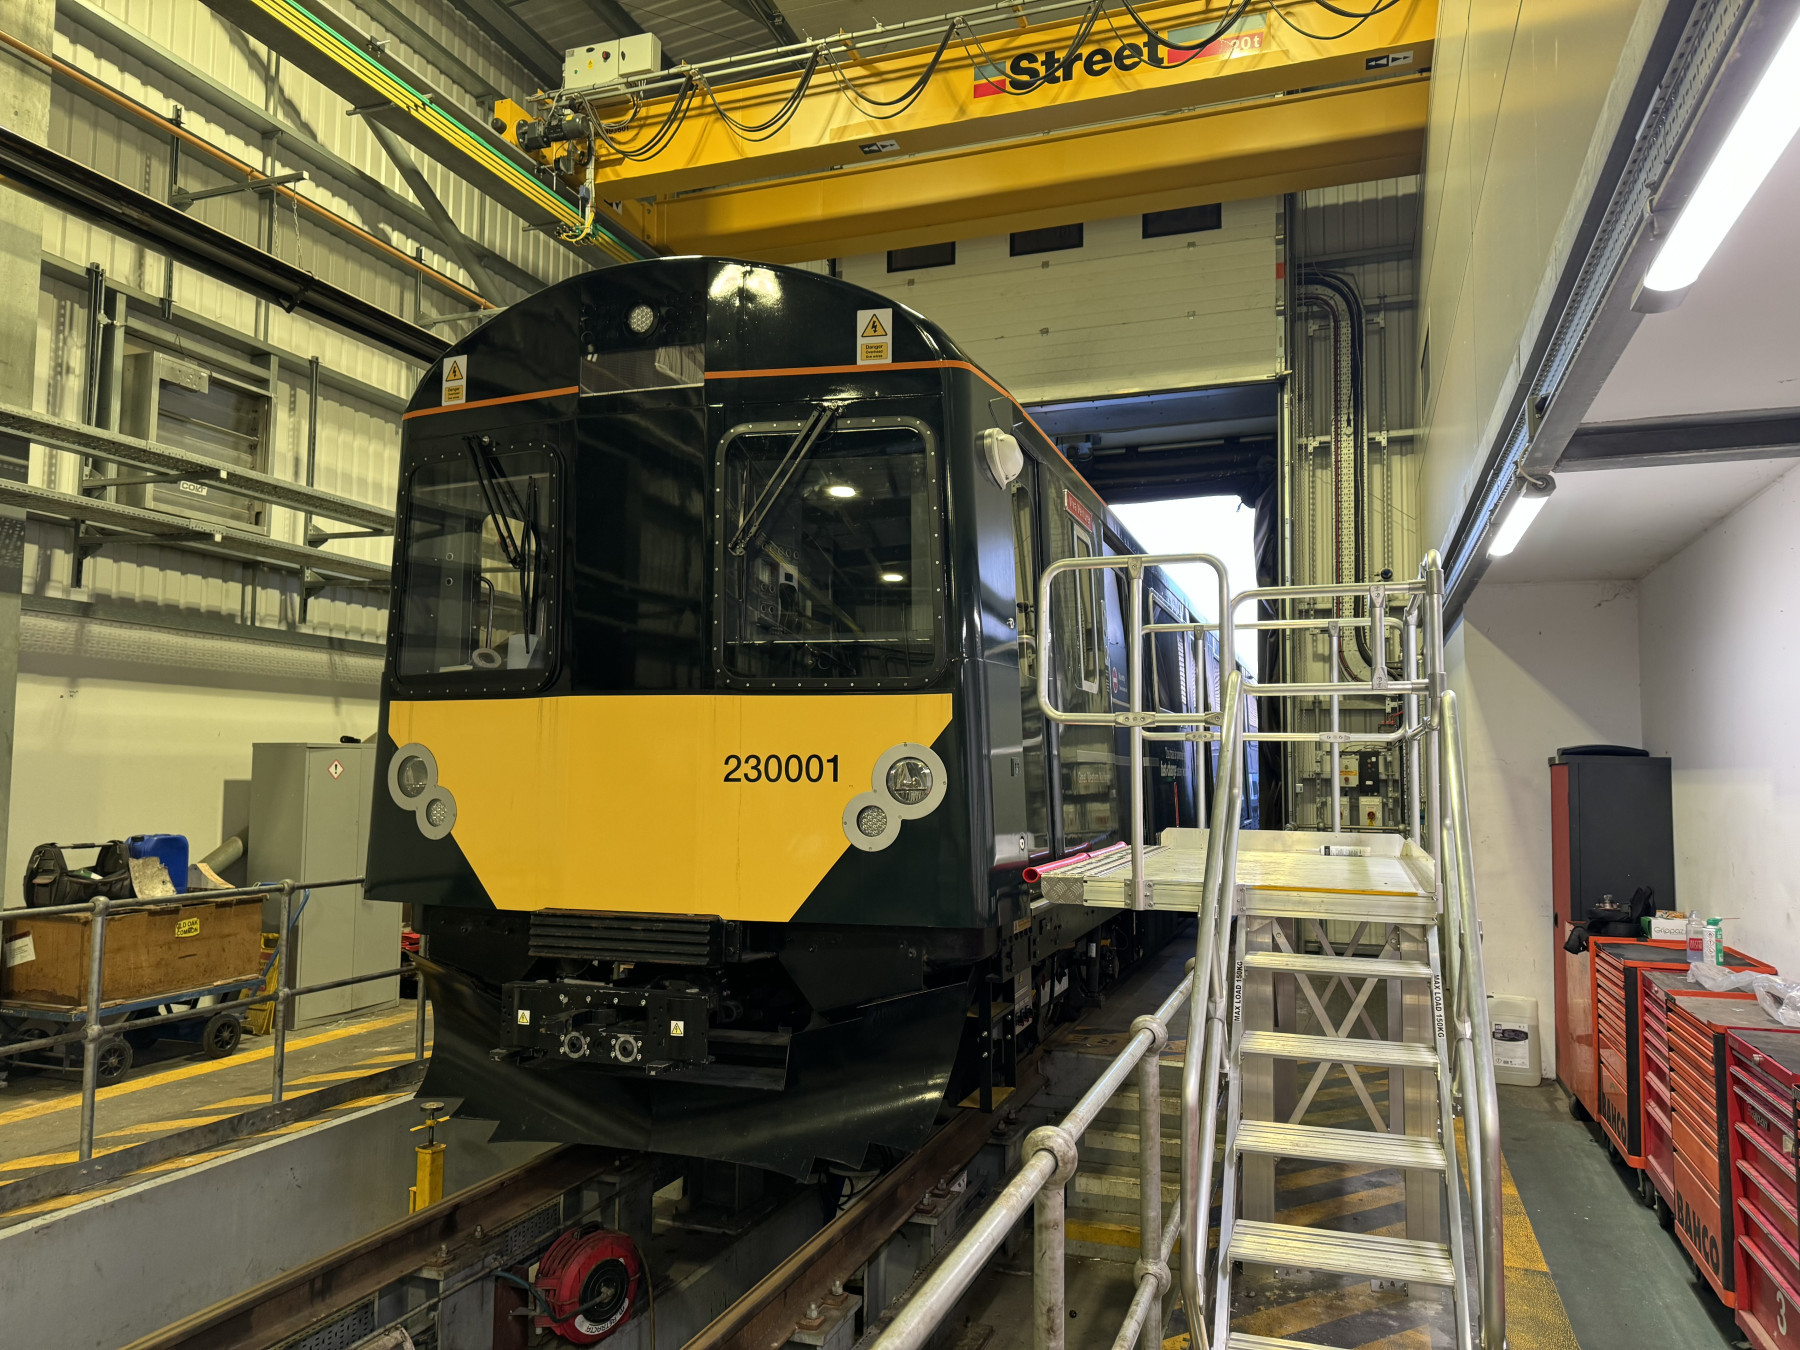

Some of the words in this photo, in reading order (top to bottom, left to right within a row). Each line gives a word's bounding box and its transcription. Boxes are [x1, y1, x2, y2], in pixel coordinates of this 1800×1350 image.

[1009, 32, 1164, 91] Street
[723, 754, 839, 783] 230001
[1435, 992, 1443, 1012] LOAD
[1436, 1014, 1445, 1038] 150KG
[1600, 1091, 1627, 1147] BAHCO
[1676, 1189, 1719, 1276] BAHCO
[1776, 1290, 1787, 1336] 3
